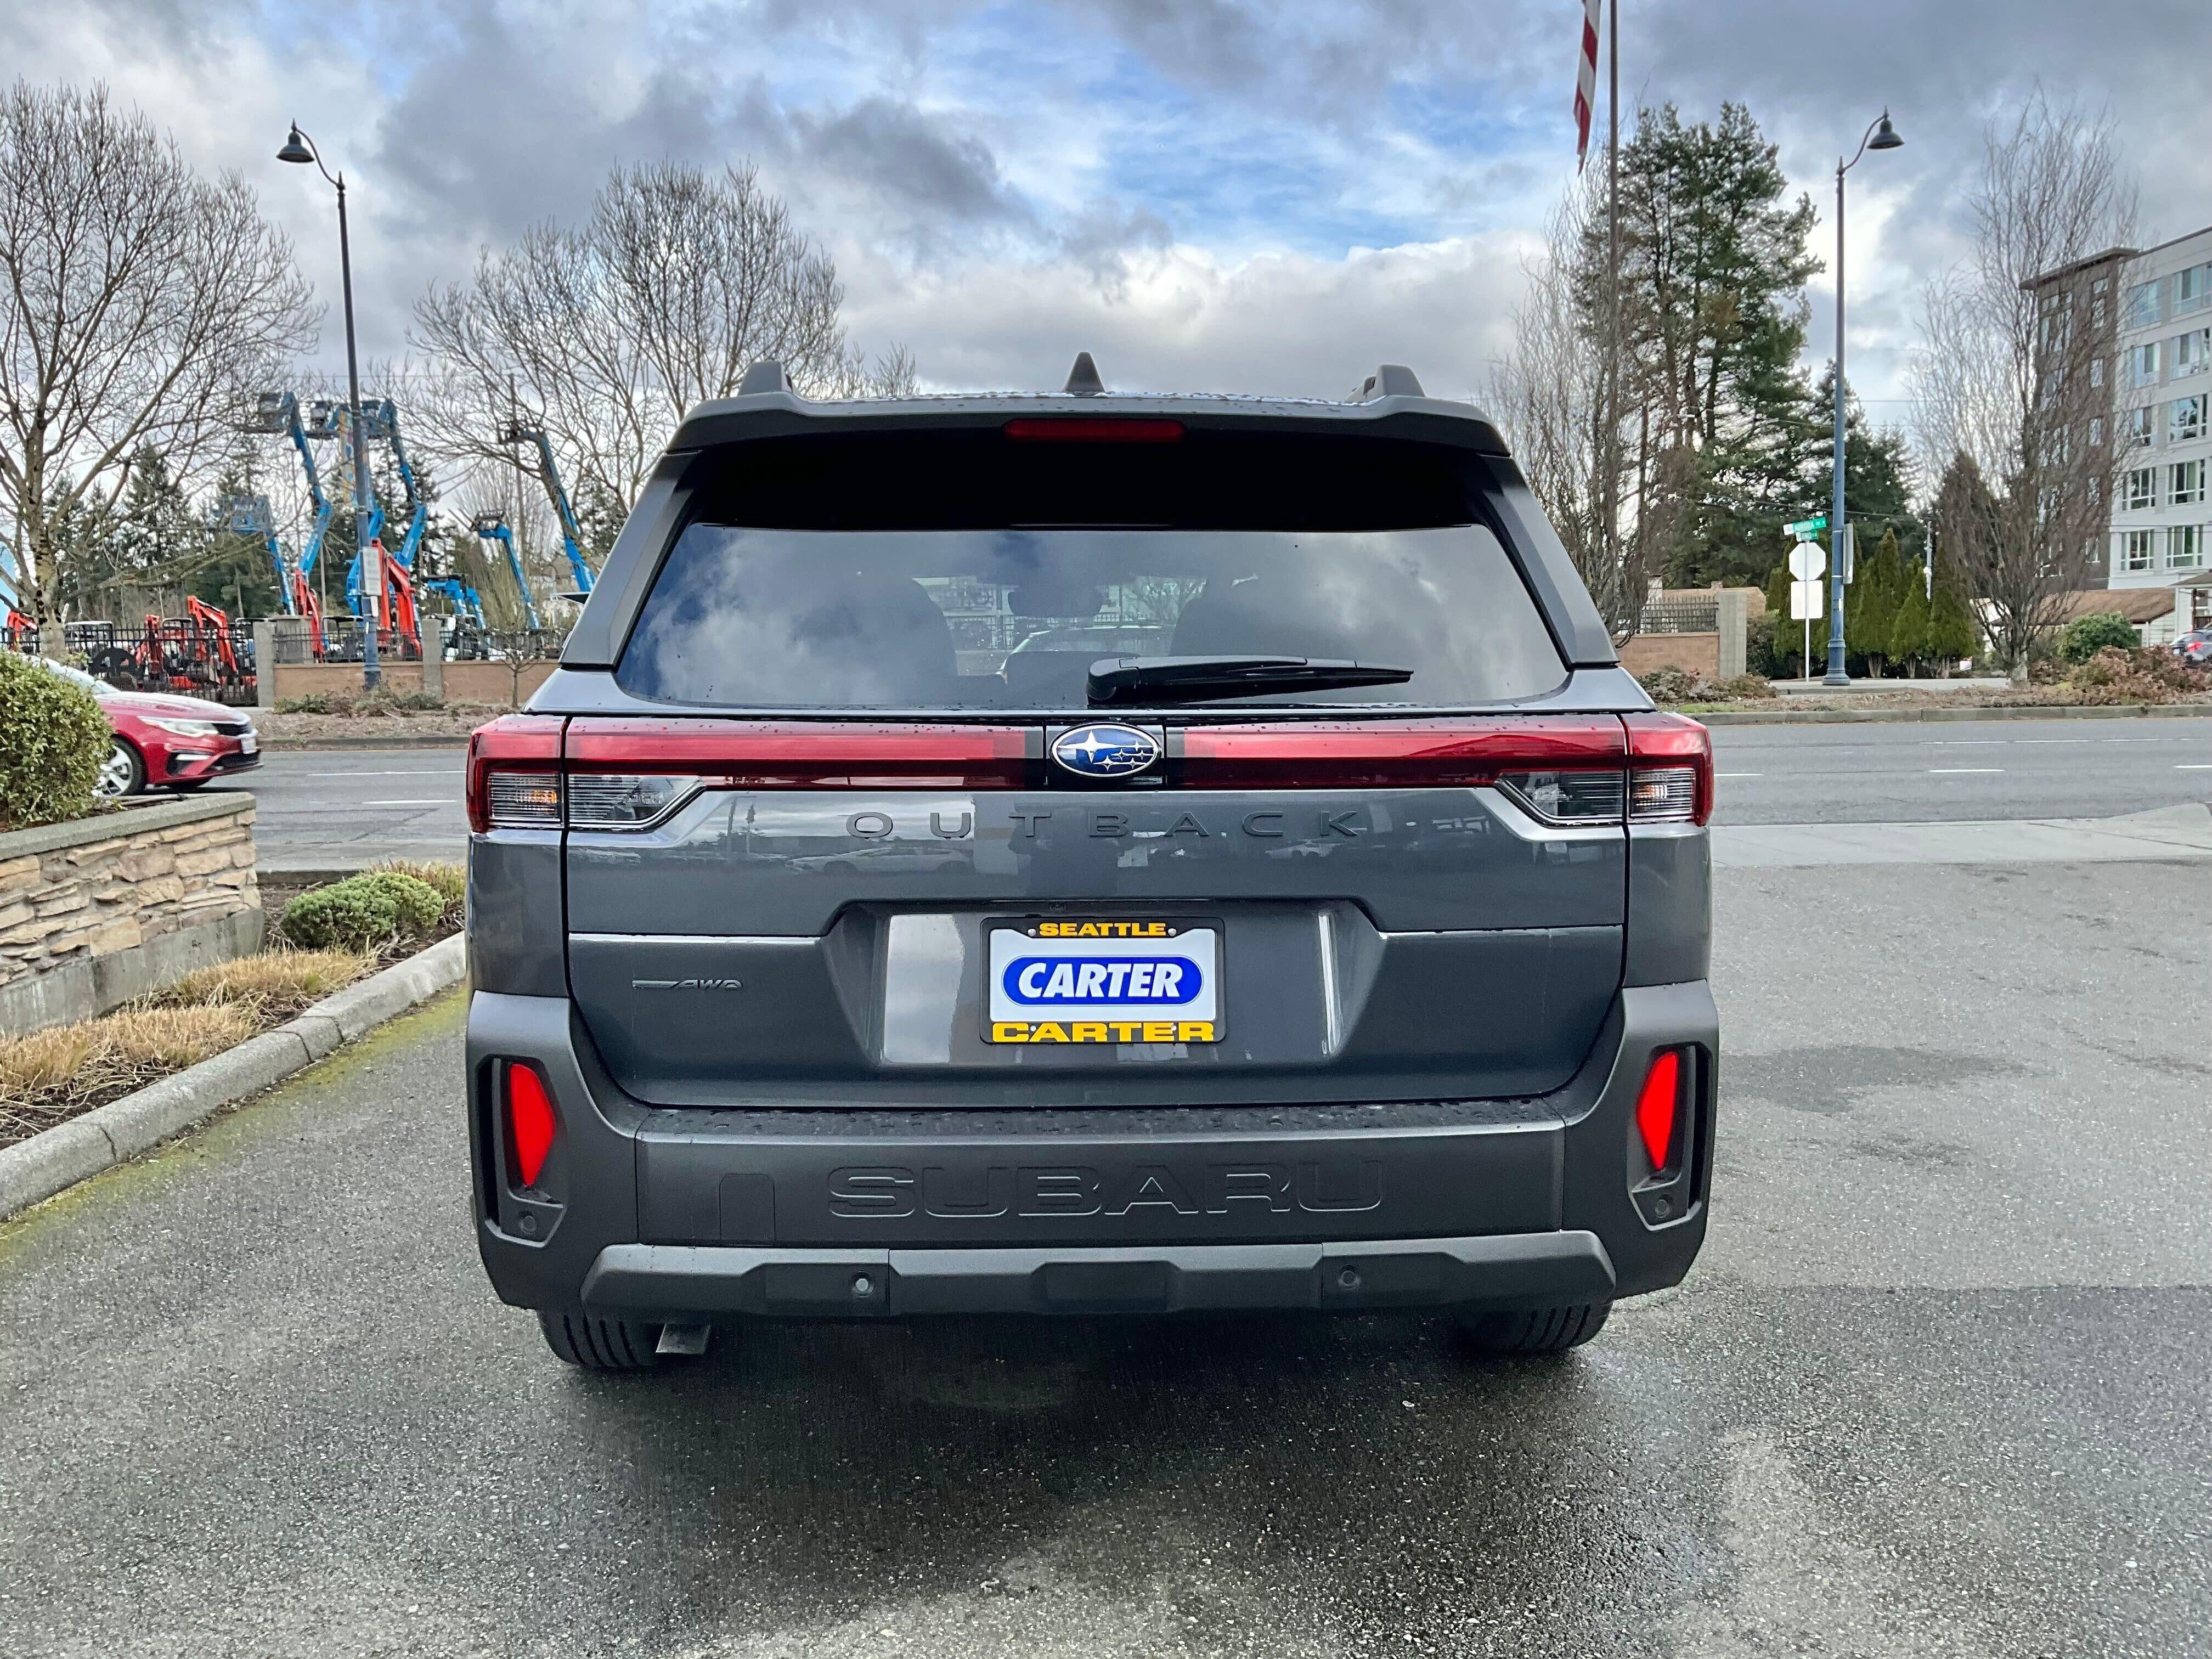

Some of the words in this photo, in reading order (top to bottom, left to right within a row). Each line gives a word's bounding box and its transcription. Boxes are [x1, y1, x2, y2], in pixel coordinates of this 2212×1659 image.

[846, 811, 1357, 838] OUTBACK
[1039, 922, 1167, 937] SEATTLE
[672, 979, 743, 990] AWD
[1018, 962, 1183, 998] CARTER
[992, 1022, 1214, 1042] CARTER
[828, 1160, 1383, 1217] SUBARU
